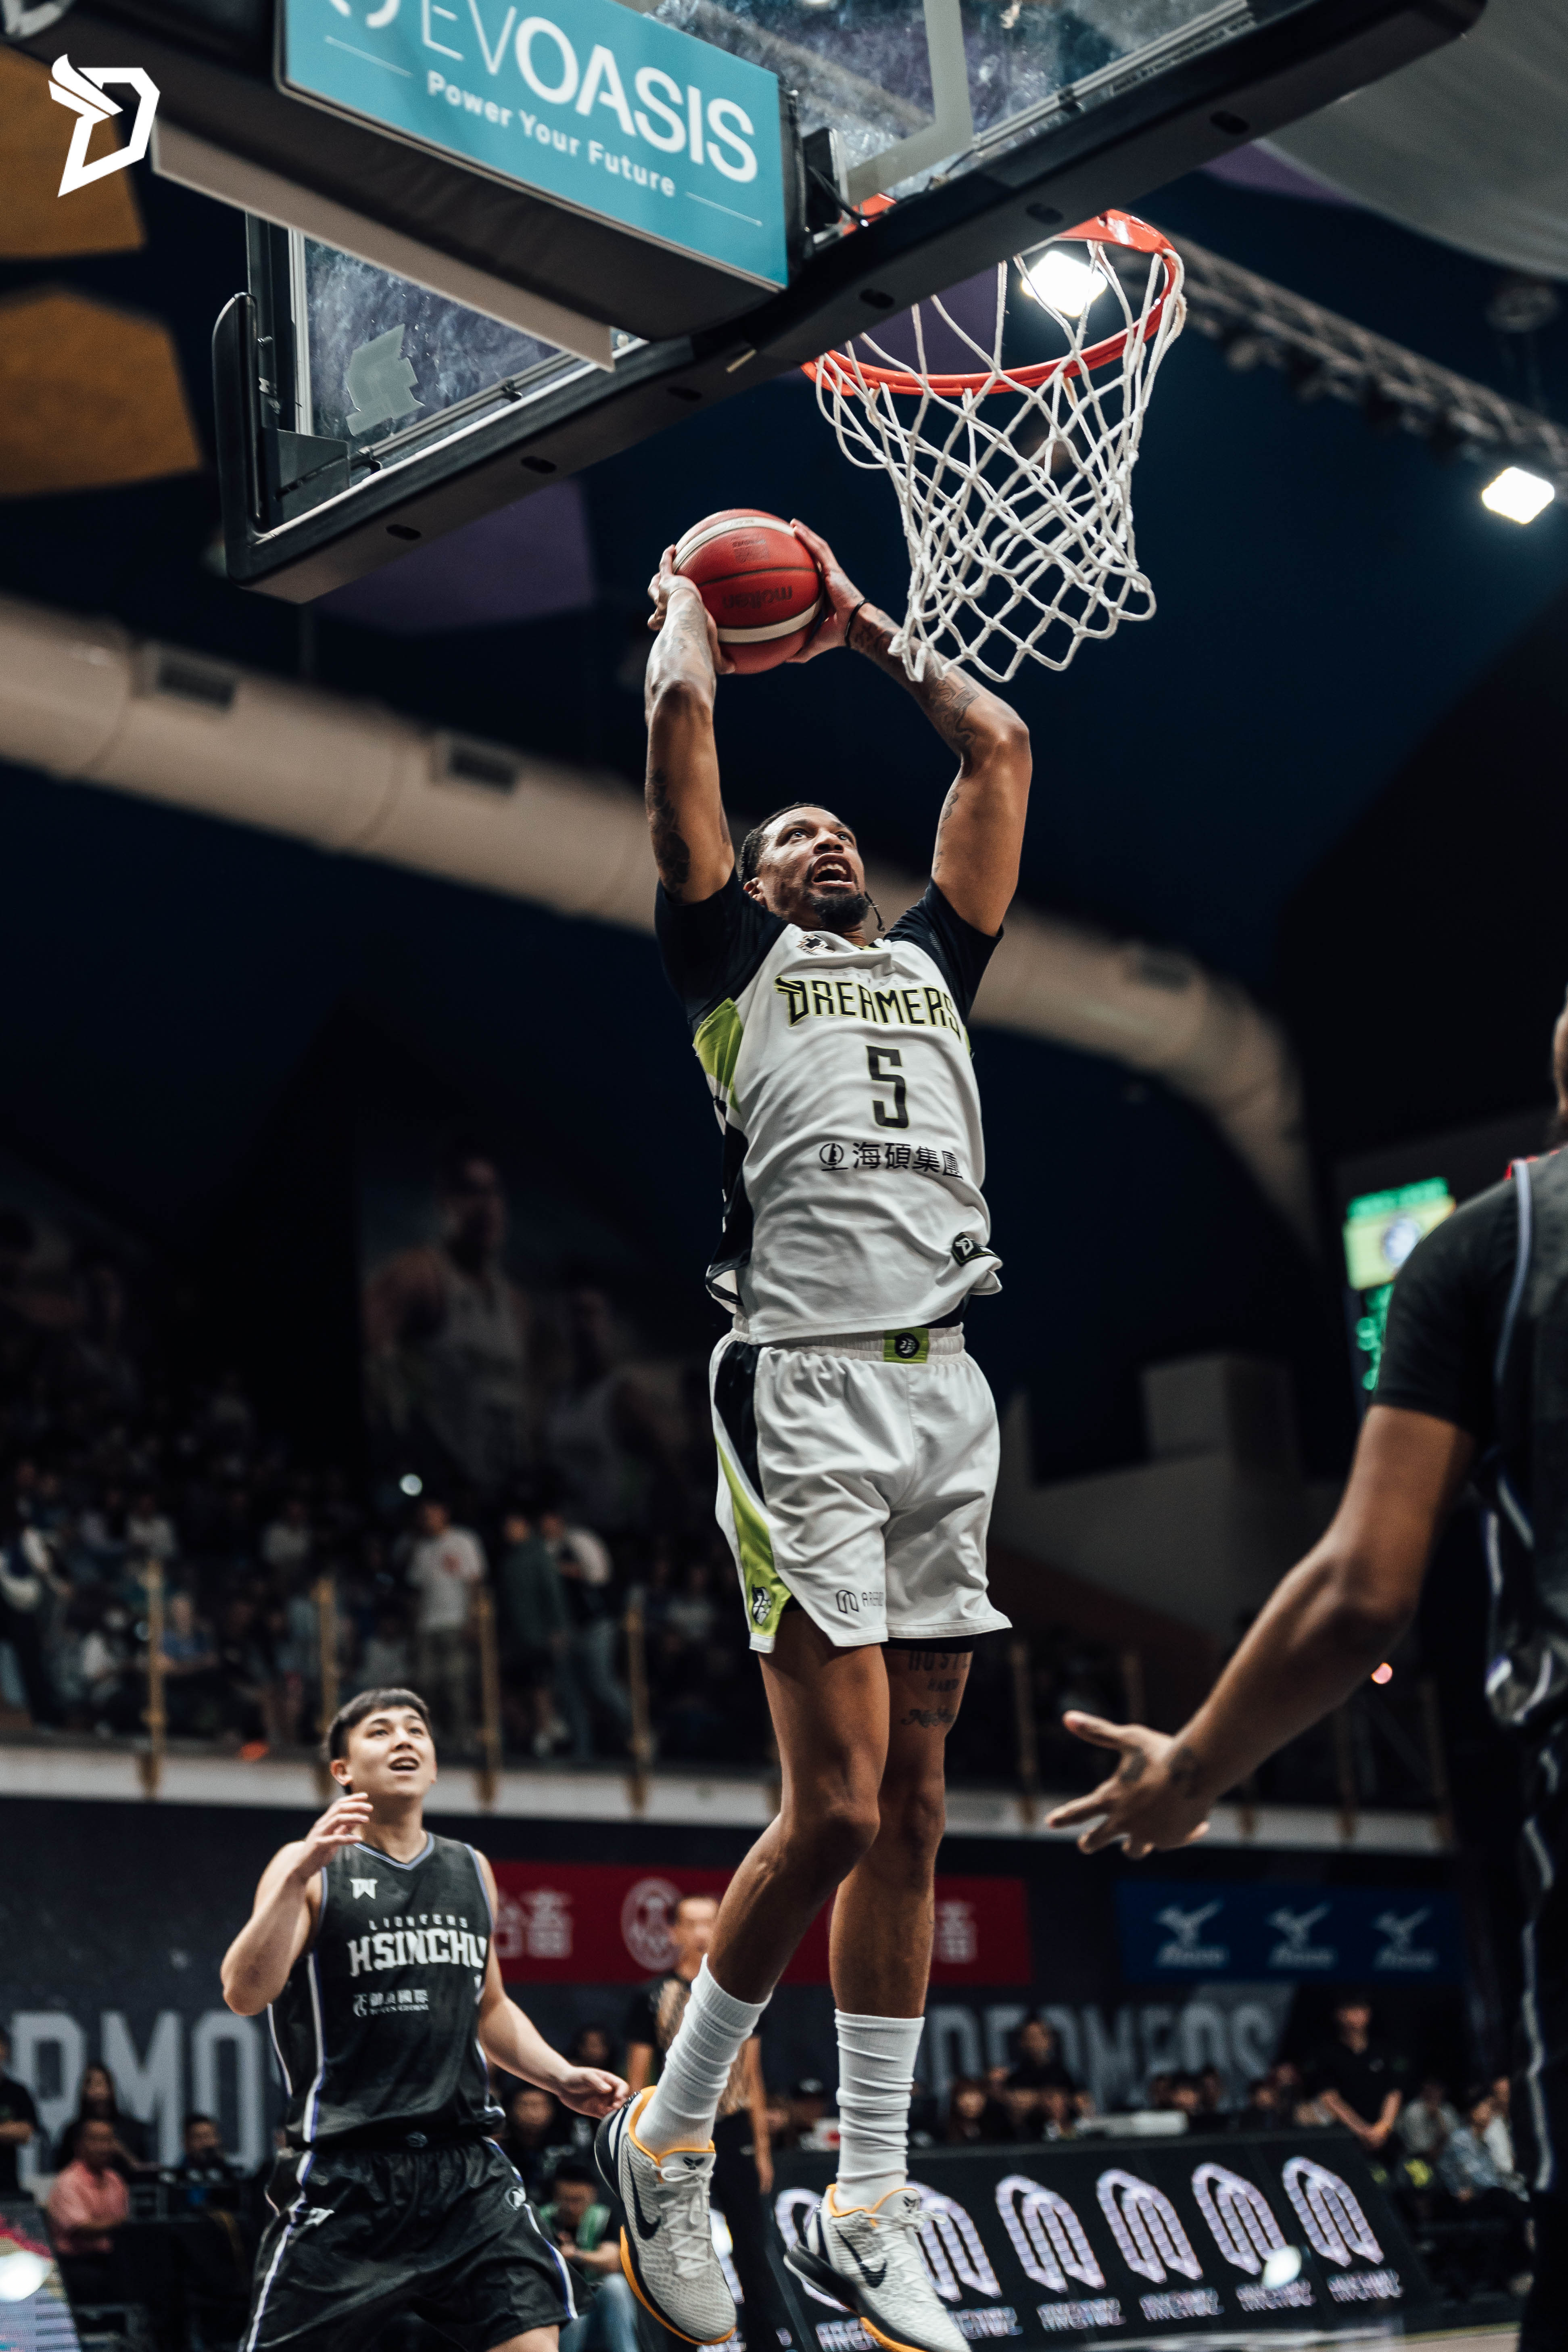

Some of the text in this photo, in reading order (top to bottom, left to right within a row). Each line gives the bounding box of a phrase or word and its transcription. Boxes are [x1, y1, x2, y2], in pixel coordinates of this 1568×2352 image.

[421, 0, 758, 183] EVOASIS
[428, 69, 676, 197] Power Your Future
[722, 585, 793, 609] molten
[774, 975, 963, 1043] DREAMERS
[865, 1045, 910, 1130] 5
[347, 1928, 487, 1977] HSINCHU
